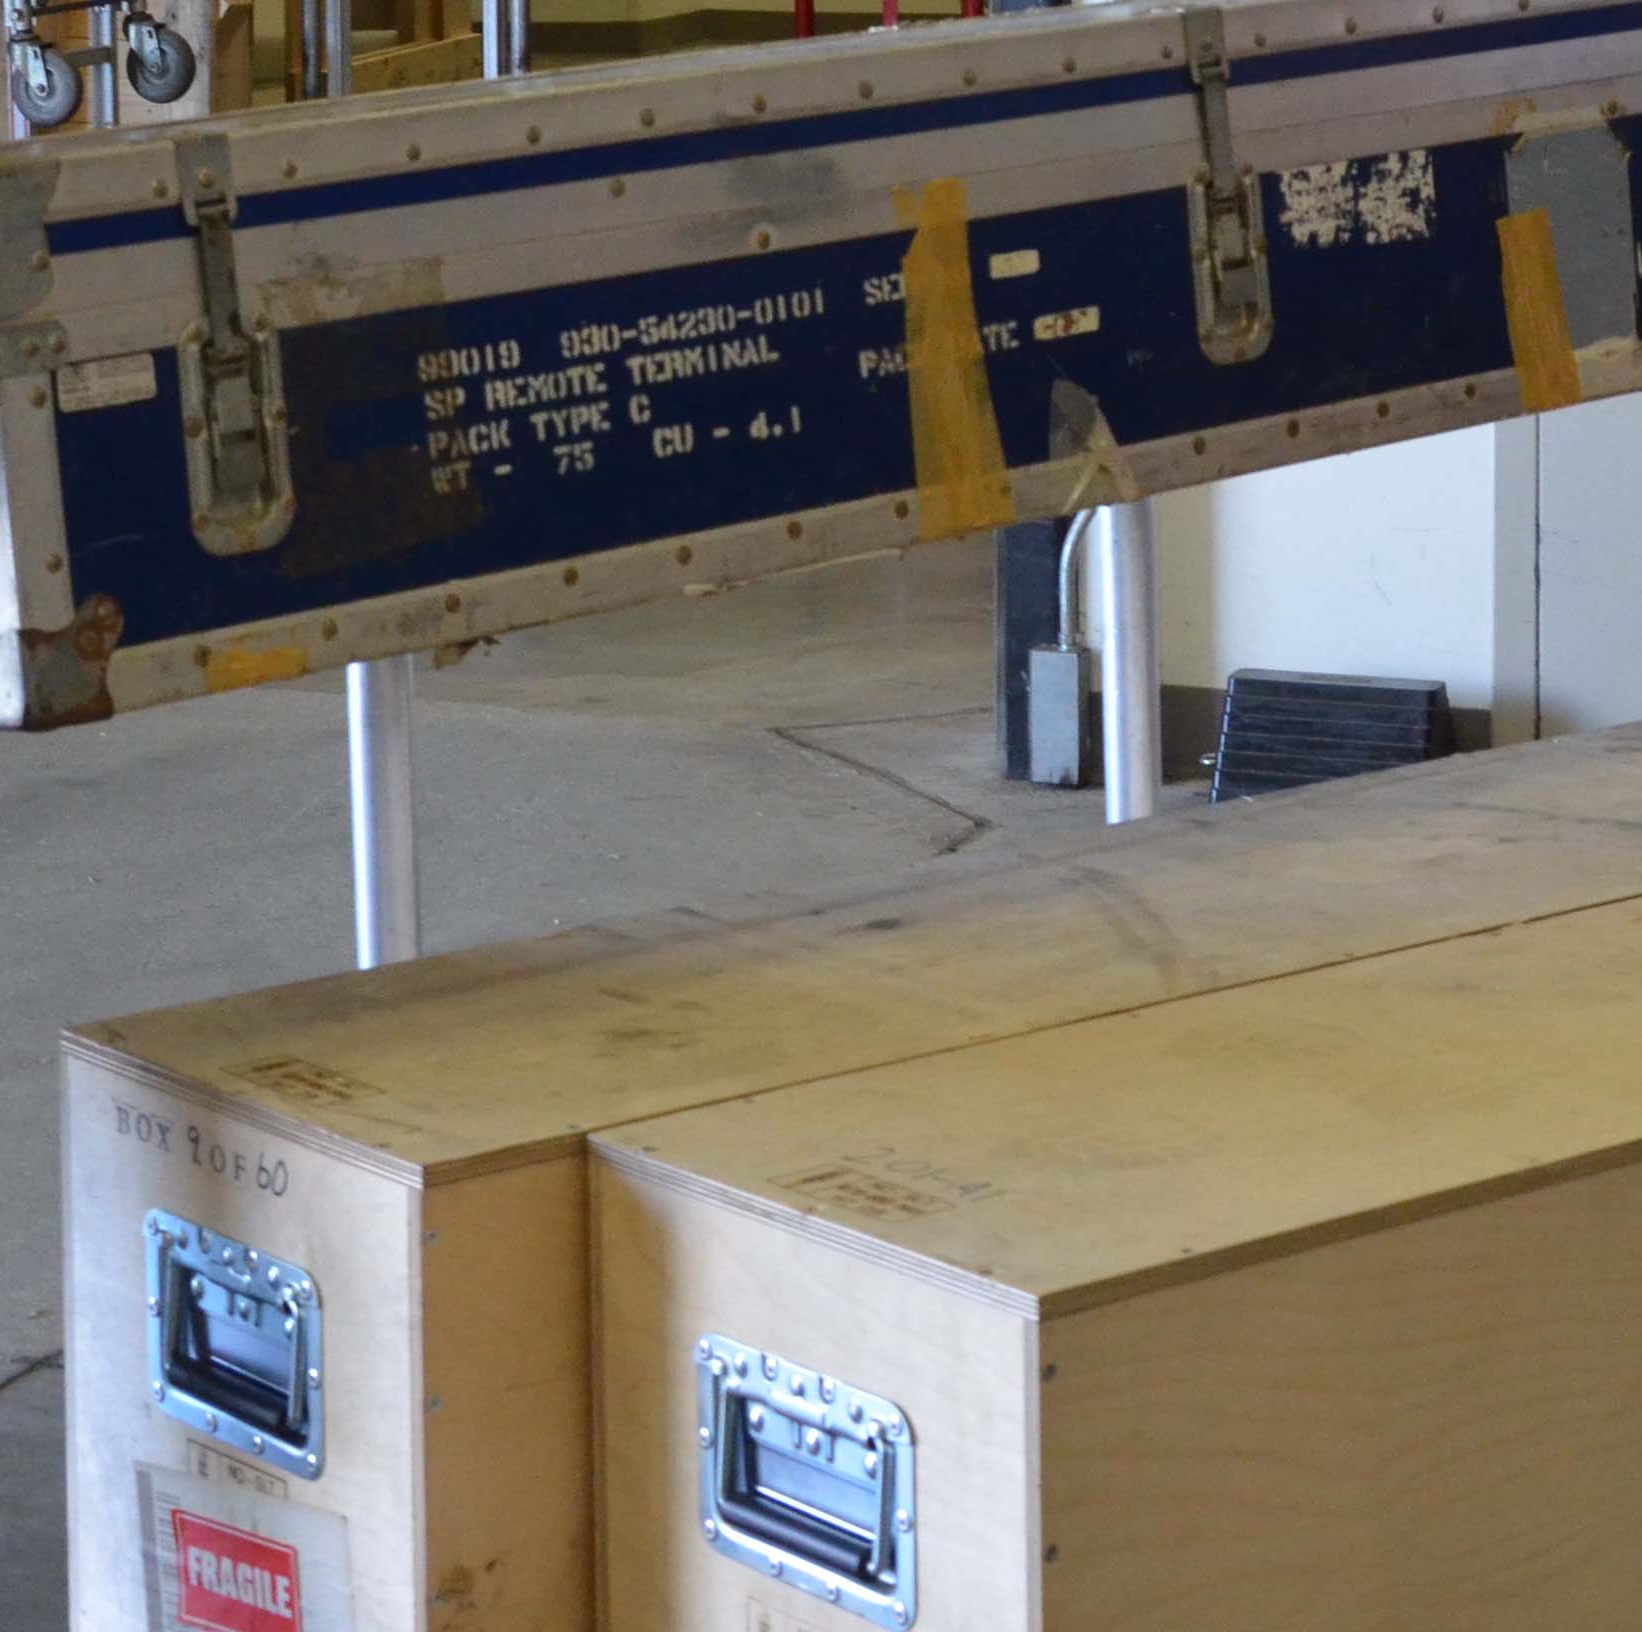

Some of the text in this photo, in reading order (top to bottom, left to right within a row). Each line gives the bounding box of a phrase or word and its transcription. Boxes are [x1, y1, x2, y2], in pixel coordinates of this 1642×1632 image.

[424, 334, 780, 419] SP REMOTE TERMINAL
[428, 394, 652, 459] PACK TYPE C
[552, 440, 595, 476] 75
[652, 422, 695, 458] CU
[114, 1103, 173, 1153] BOX
[209, 1143, 246, 1183] OF
[256, 1152, 290, 1197] 60
[187, 1544, 294, 1619] FRAGILE
